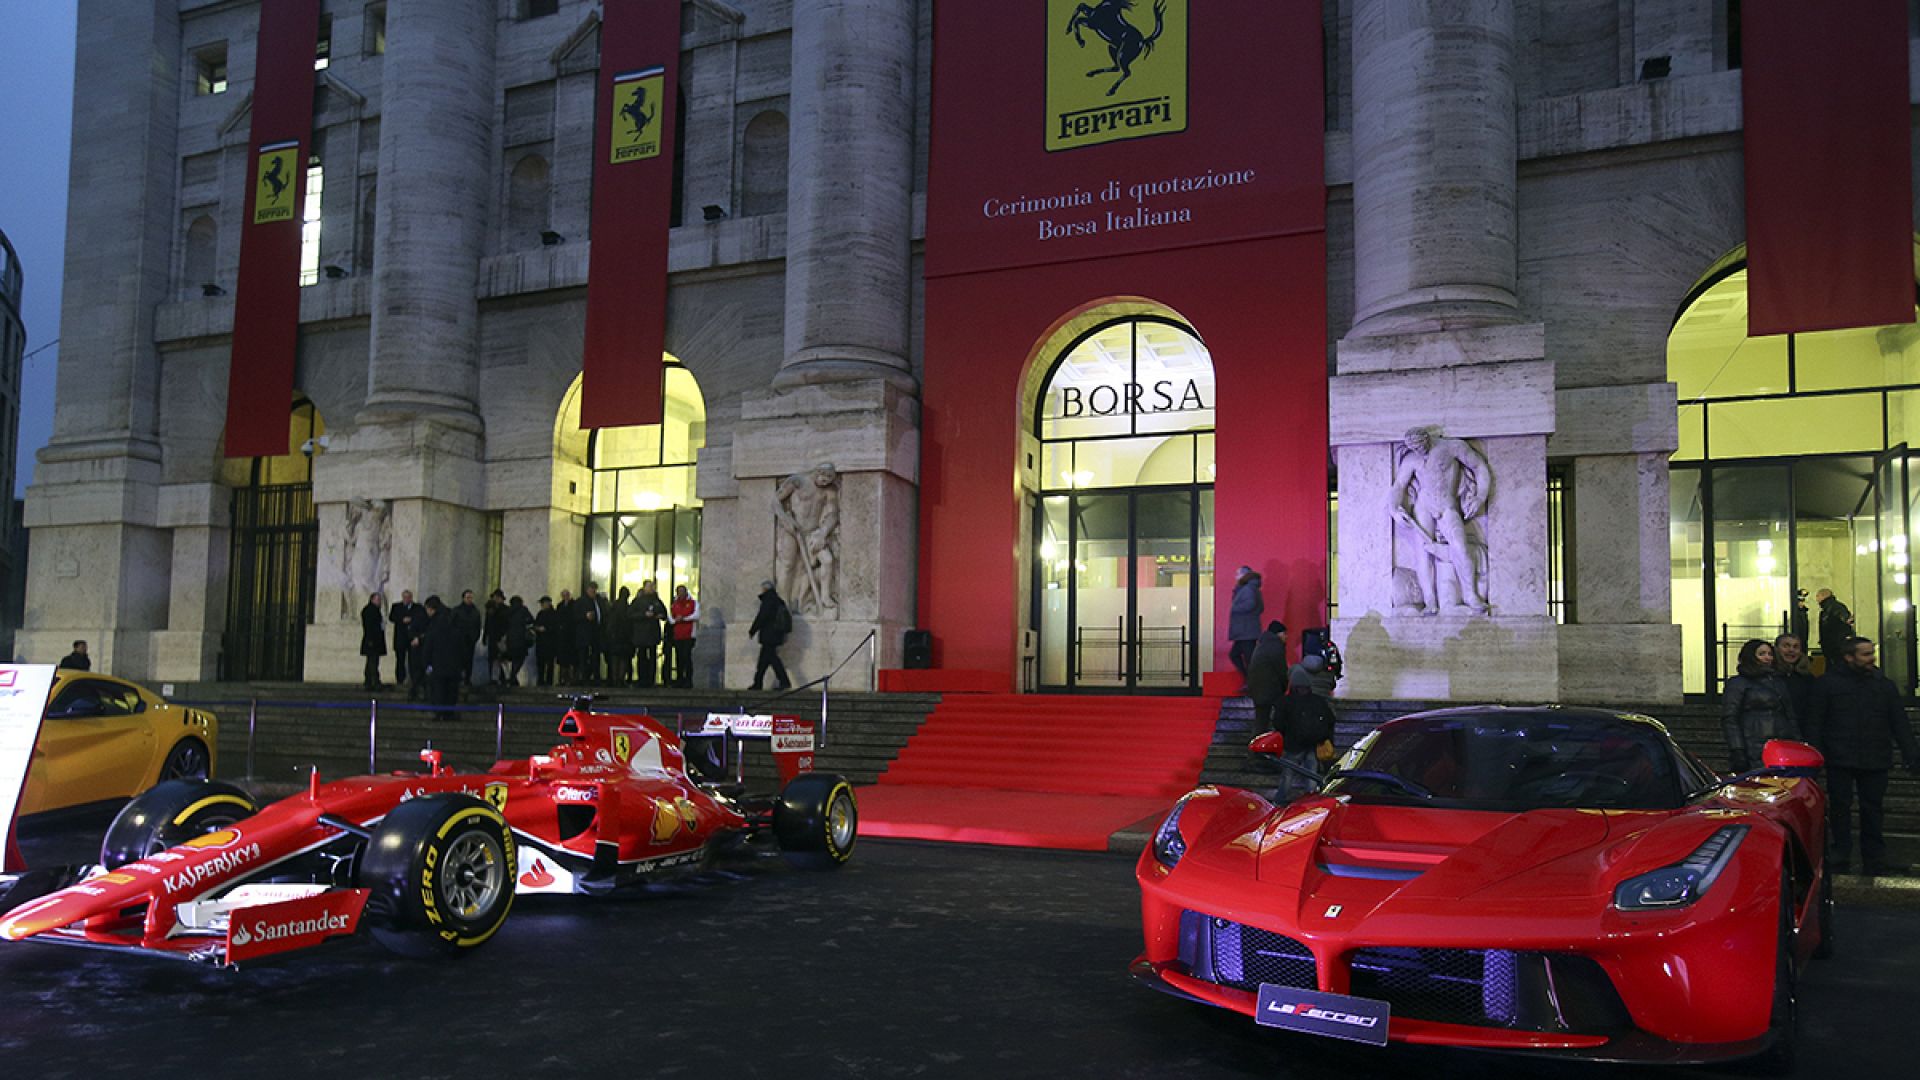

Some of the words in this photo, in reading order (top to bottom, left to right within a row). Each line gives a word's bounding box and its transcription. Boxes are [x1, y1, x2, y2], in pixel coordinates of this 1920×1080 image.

[1058, 96, 1171, 139] Ferrari
[615, 141, 657, 159] Ferrari
[983, 187, 1093, 218] Cerimonia
[1100, 180, 1121, 202] di
[1129, 168, 1256, 204] quotazione
[1038, 219, 1097, 241] Borsa
[1106, 205, 1192, 232] Italiana
[1063, 379, 1204, 418] BORSA
[163, 848, 251, 894] KASPERSKY
[421, 844, 443, 925] ZERO
[253, 909, 350, 942] Santander
[1267, 1000, 1379, 1028] LaFerrari
